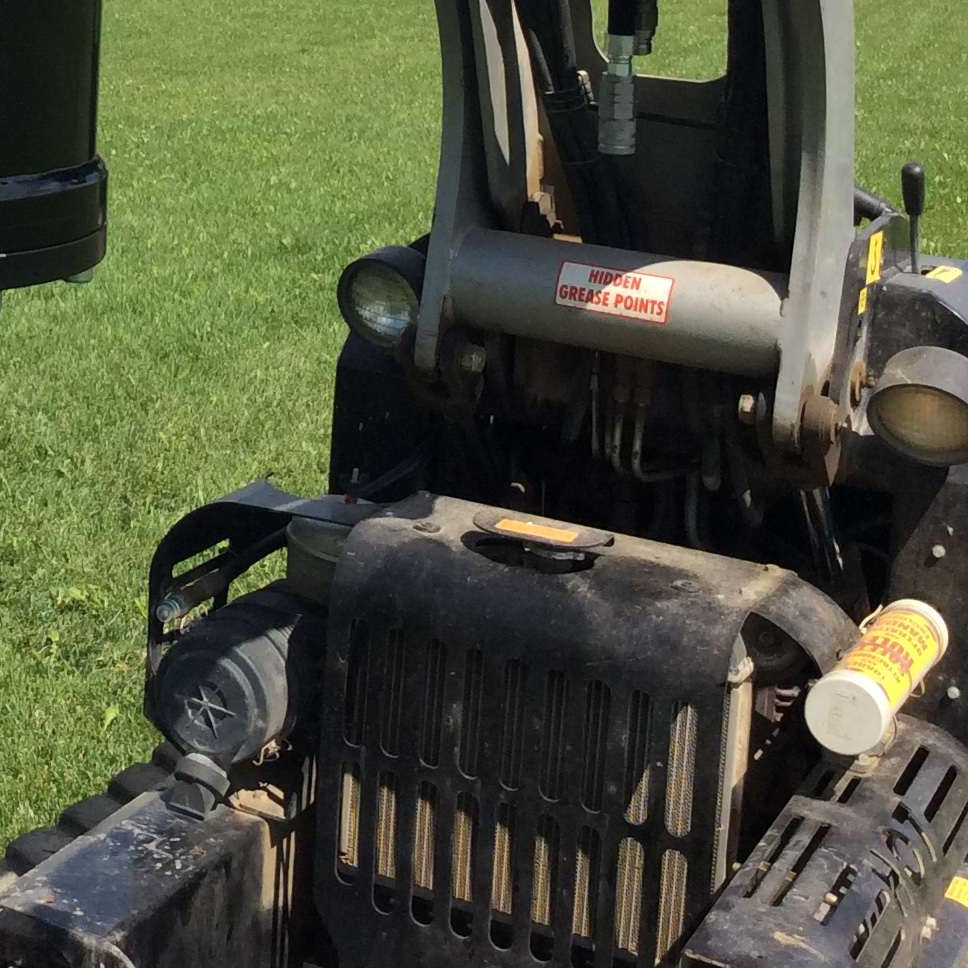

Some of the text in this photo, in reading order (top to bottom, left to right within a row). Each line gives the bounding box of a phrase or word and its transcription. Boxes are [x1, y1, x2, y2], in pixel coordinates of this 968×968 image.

[588, 269, 642, 291] HIDDEN
[558, 284, 665, 316] GREASE POINTS
